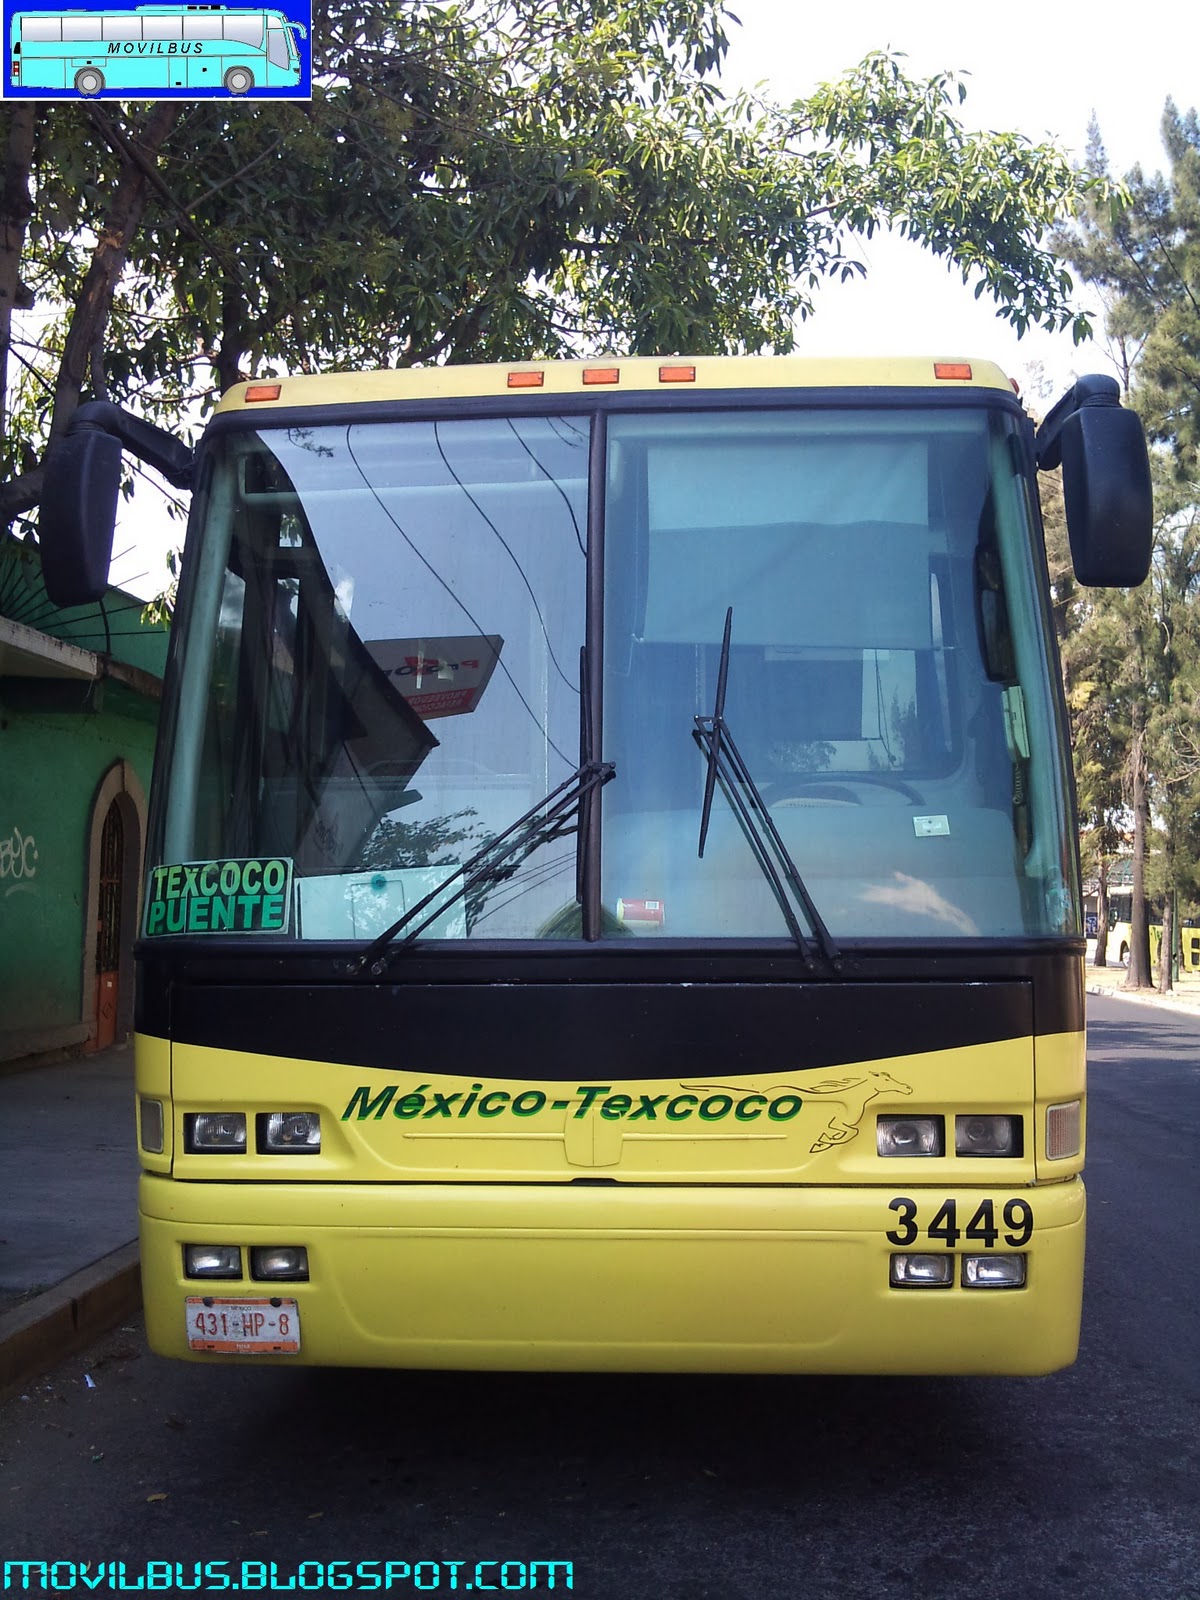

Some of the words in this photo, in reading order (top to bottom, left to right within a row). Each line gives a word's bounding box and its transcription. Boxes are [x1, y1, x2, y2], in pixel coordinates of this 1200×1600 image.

[154, 860, 285, 900] TEXCOCO
[148, 895, 284, 934] PUENTE
[340, 1083, 803, 1121] México-Texcoco
[886, 1197, 1034, 1247] 3449
